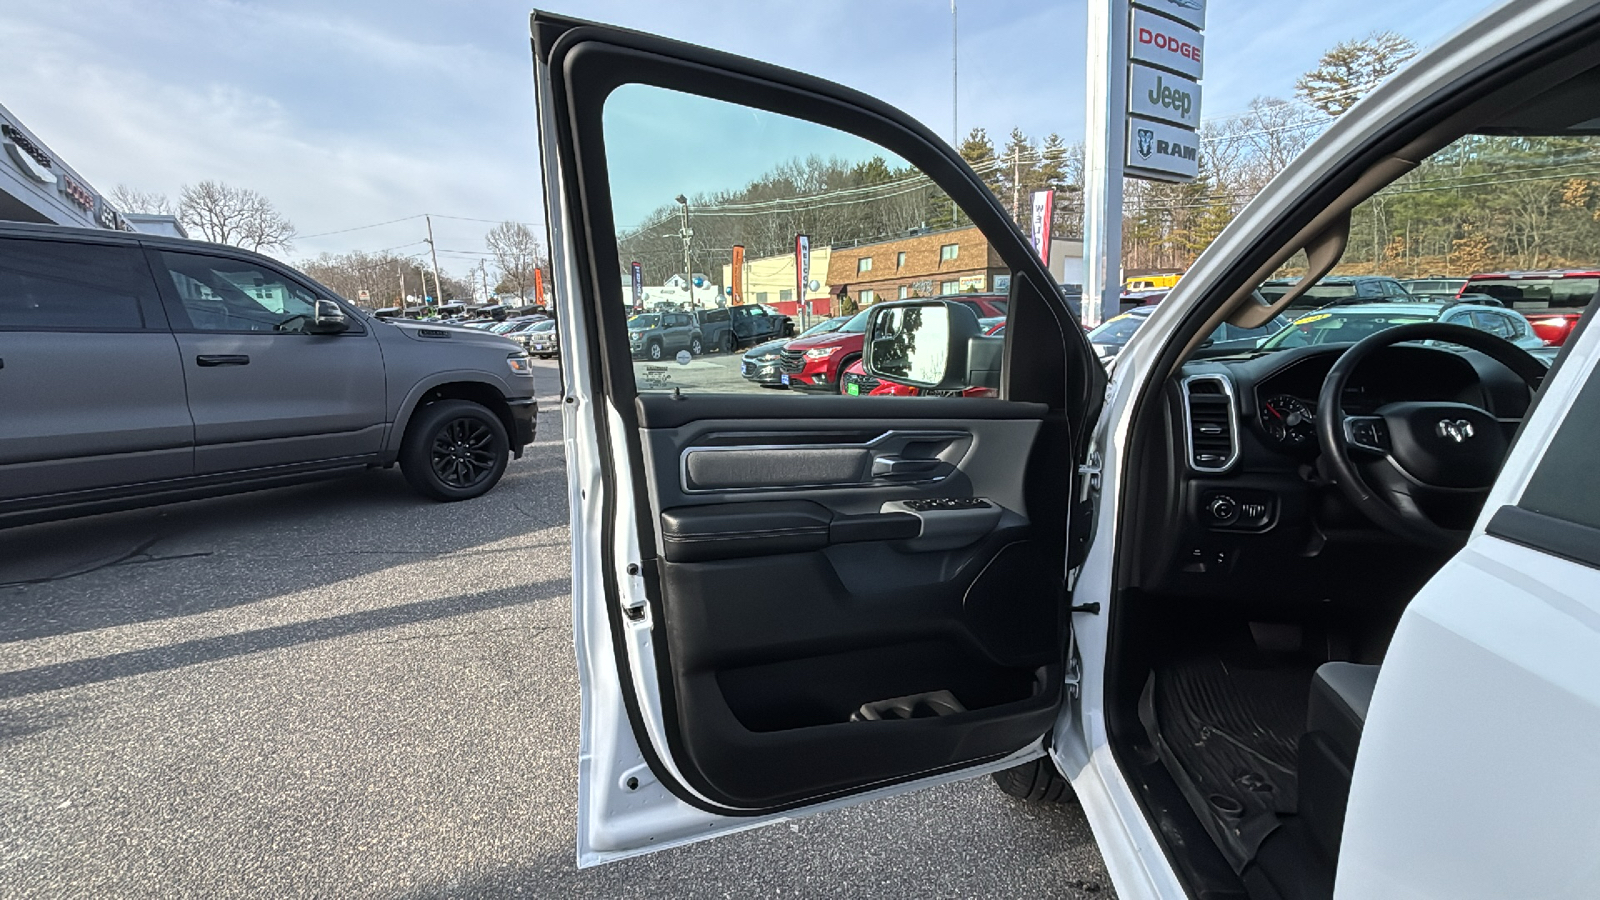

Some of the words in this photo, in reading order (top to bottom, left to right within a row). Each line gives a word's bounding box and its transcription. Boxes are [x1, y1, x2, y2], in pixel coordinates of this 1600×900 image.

[1139, 28, 1200, 62] DODGE
[1148, 76, 1191, 118] Jeep
[1157, 139, 1196, 161] RAM
